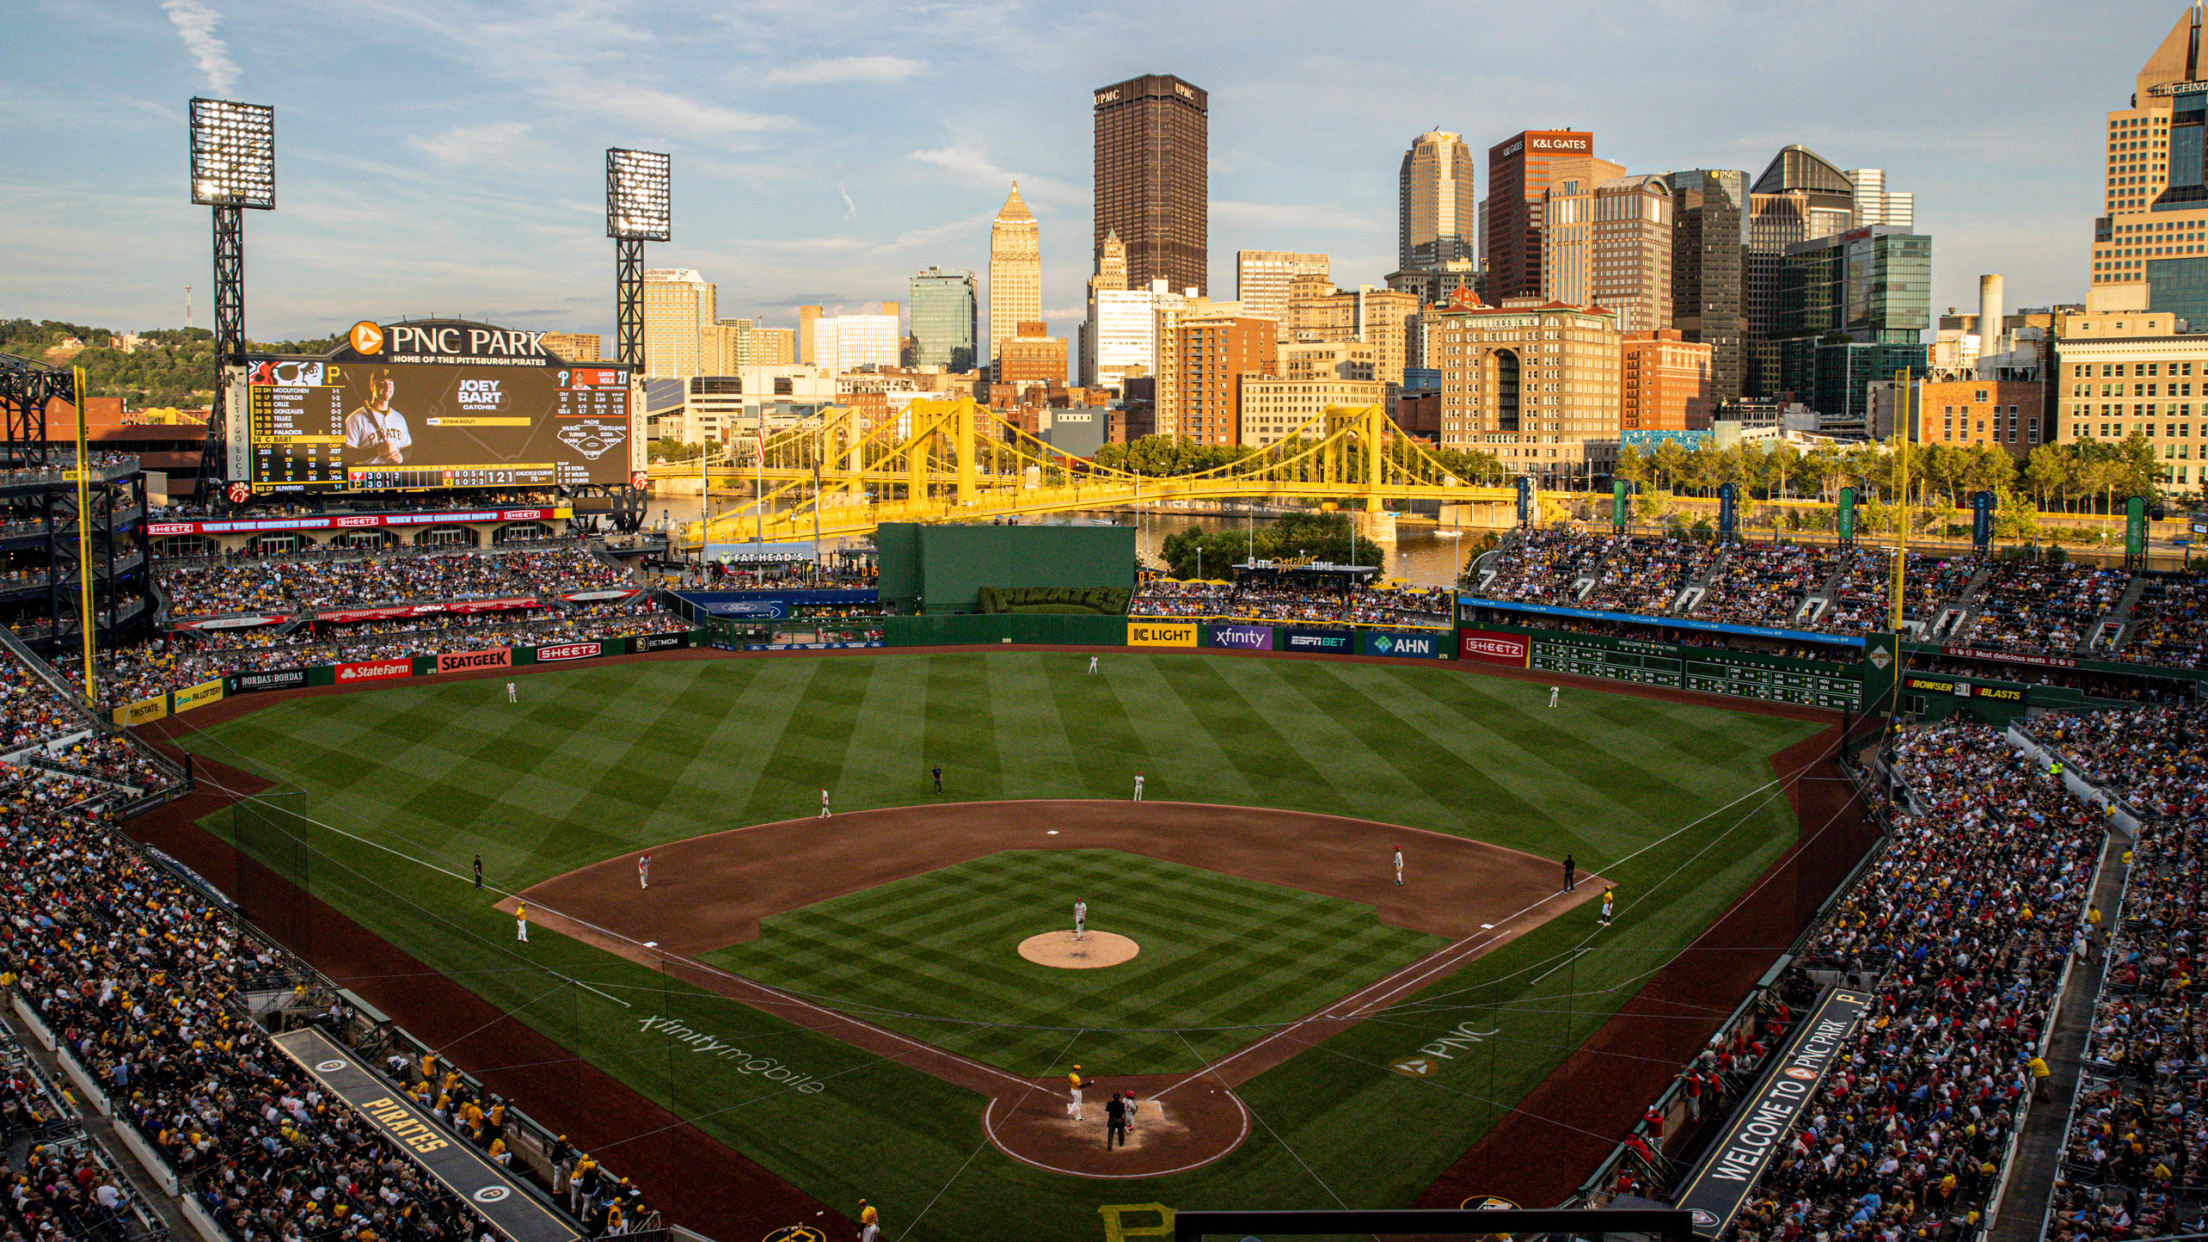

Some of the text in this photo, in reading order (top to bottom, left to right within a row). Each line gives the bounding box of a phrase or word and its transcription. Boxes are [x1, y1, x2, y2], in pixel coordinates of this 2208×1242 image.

[1094, 90, 1120, 105] UPMC
[1175, 83, 1195, 100] UPMC
[1533, 139, 1586, 149] K&L GATES
[389, 326, 547, 356] PNC PARK
[394, 355, 421, 363] HOME
[437, 356, 454, 364] THE
[458, 357, 510, 365] PITTSBURGH
[512, 358, 546, 366] PIRATES
[327, 366, 340, 384] P
[558, 370, 569, 387] P
[618, 371, 628, 384] 27
[459, 380, 500, 391] JOEY
[458, 392, 502, 404] BART
[489, 472, 513, 482] 1 2 1
[339, 518, 378, 526] SHEETZ
[735, 553, 803, 562] FAT HEAD'S
[1257, 554, 1334, 574] IT'S Miller TIME
[1134, 629, 1192, 641] IC LIGHT
[1216, 628, 1265, 647] xfinity
[1291, 636, 1346, 647] ESPN BET
[650, 638, 678, 646] BETMGM
[1394, 639, 1429, 654] AHN
[1470, 641, 1519, 654] SHEETZ
[1619, 640, 1642, 648] WELCOME
[542, 646, 597, 659] SHEETZ
[1993, 651, 2025, 663] delicious
[442, 651, 507, 670] SEATGEEK
[1787, 666, 1840, 677] LEAGUE
[242, 672, 303, 685] BORDAS BORDAS
[1912, 679, 2021, 700] BOWSER BLASTS
[130, 703, 159, 718] TRISTATE
[1836, 994, 1865, 1005] P
[1416, 1021, 1500, 1060] PNC
[638, 1015, 825, 1094] xfinity mobile
[1712, 1018, 1848, 1181] WELCOME TO PNC PARK
[361, 1097, 449, 1154] PIRATES
[1097, 1202, 1178, 1242] P
